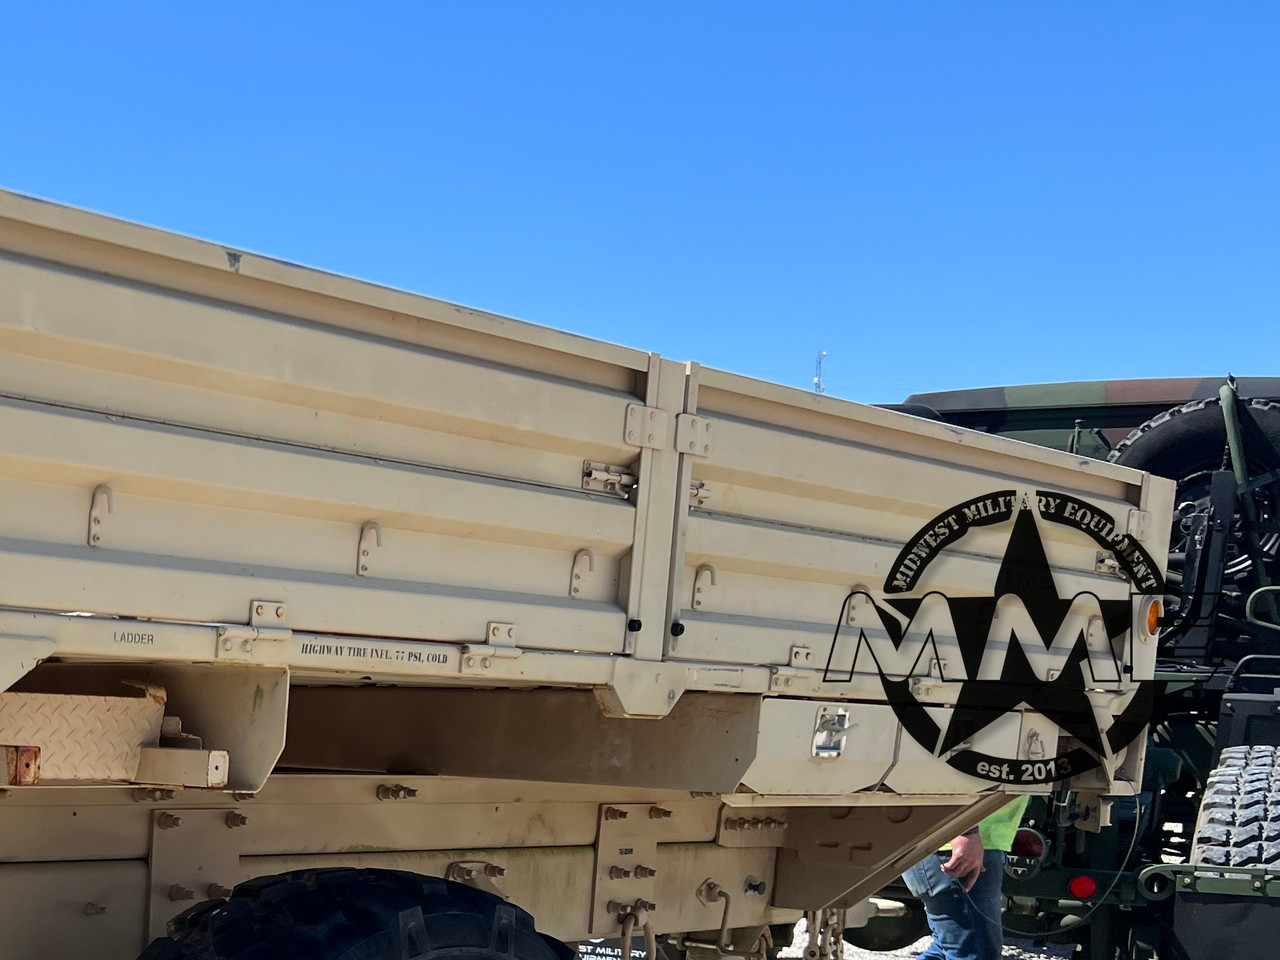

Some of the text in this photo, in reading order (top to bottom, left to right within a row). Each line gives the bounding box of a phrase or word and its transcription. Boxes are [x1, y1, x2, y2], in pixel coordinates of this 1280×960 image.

[113, 631, 154, 645] LADDER
[300, 643, 345, 656] HIGHWAY
[347, 646, 368, 658] TIRE
[370, 648, 392, 660] INFL.
[426, 653, 448, 664] COLD
[595, 946, 647, 958] MILITRY
